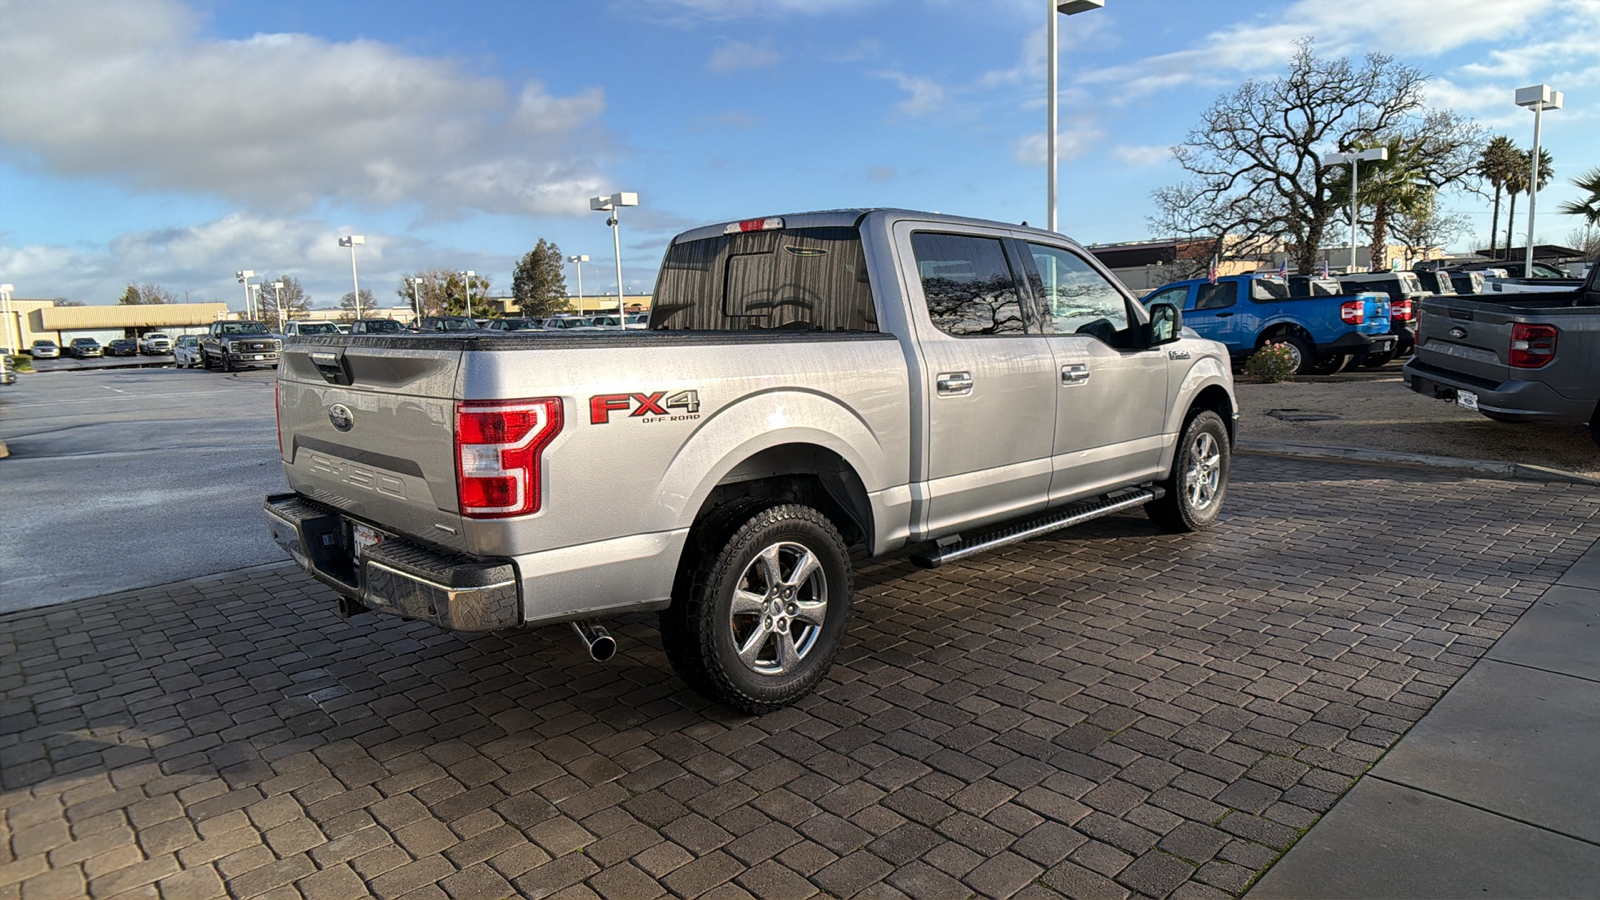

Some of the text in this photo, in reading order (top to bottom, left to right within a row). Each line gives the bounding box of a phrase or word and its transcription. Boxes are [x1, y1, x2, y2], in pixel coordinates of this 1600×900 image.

[589, 390, 700, 425] FX4
[642, 416, 666, 424] OFF
[309, 454, 408, 500] F-150
